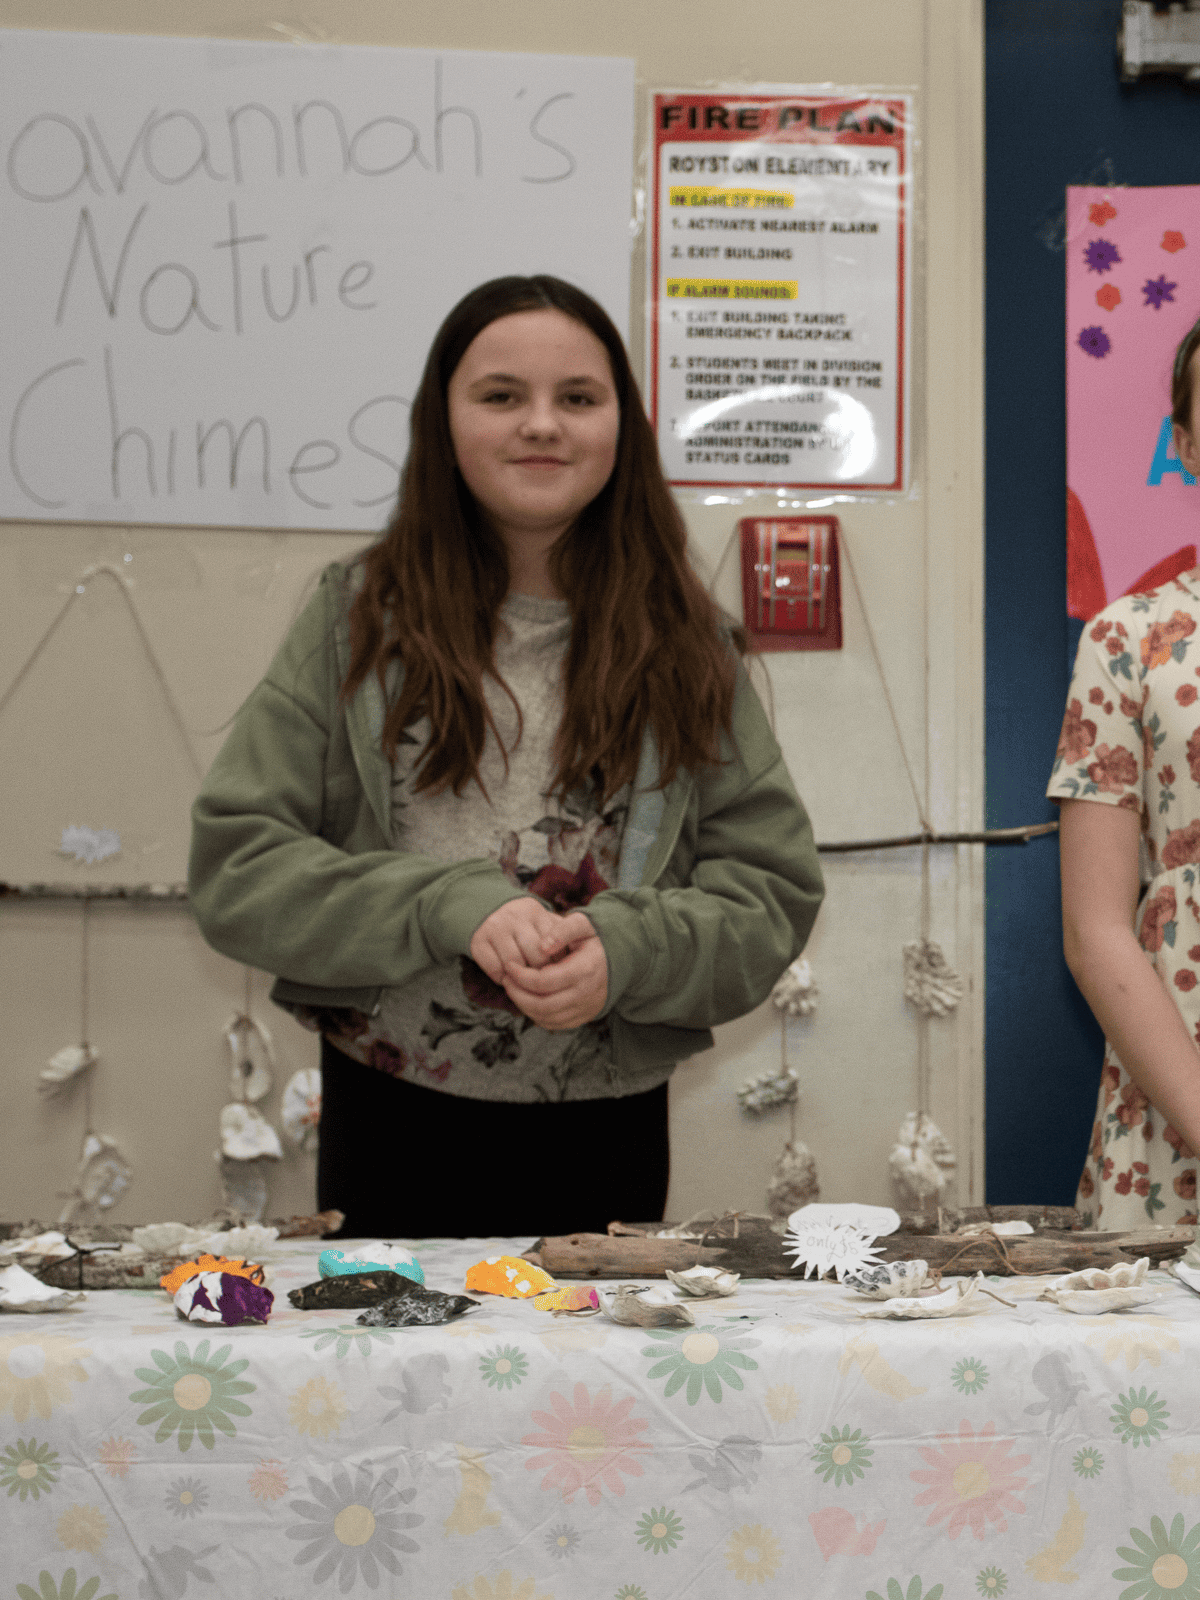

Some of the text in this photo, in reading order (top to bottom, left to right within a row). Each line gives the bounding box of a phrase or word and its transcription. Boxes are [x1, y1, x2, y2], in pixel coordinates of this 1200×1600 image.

[660, 105, 896, 134] FIRE PLAN
[669, 155, 890, 177] ROYSTON ELEMENTARY
[672, 218, 879, 234] 1. ACTIVATE NEAREST ALARM
[671, 246, 793, 260] 2. EXIT BUILDING
[56, 201, 379, 336] Nature
[684, 285, 730, 297] ALARM
[686, 311, 718, 323] EXIT
[723, 311, 789, 324] BUILDING
[794, 313, 847, 325] TAKING
[686, 327, 853, 341] EMERGENCY BACKPACK
[670, 356, 883, 373] 2. STUDENTS MEET IN DIVISION
[686, 373, 883, 389] ORDER ON THE FIELD BY THE
[686, 435, 803, 449] ADMINISTRATION
[686, 451, 791, 466] STATUS CARDS
